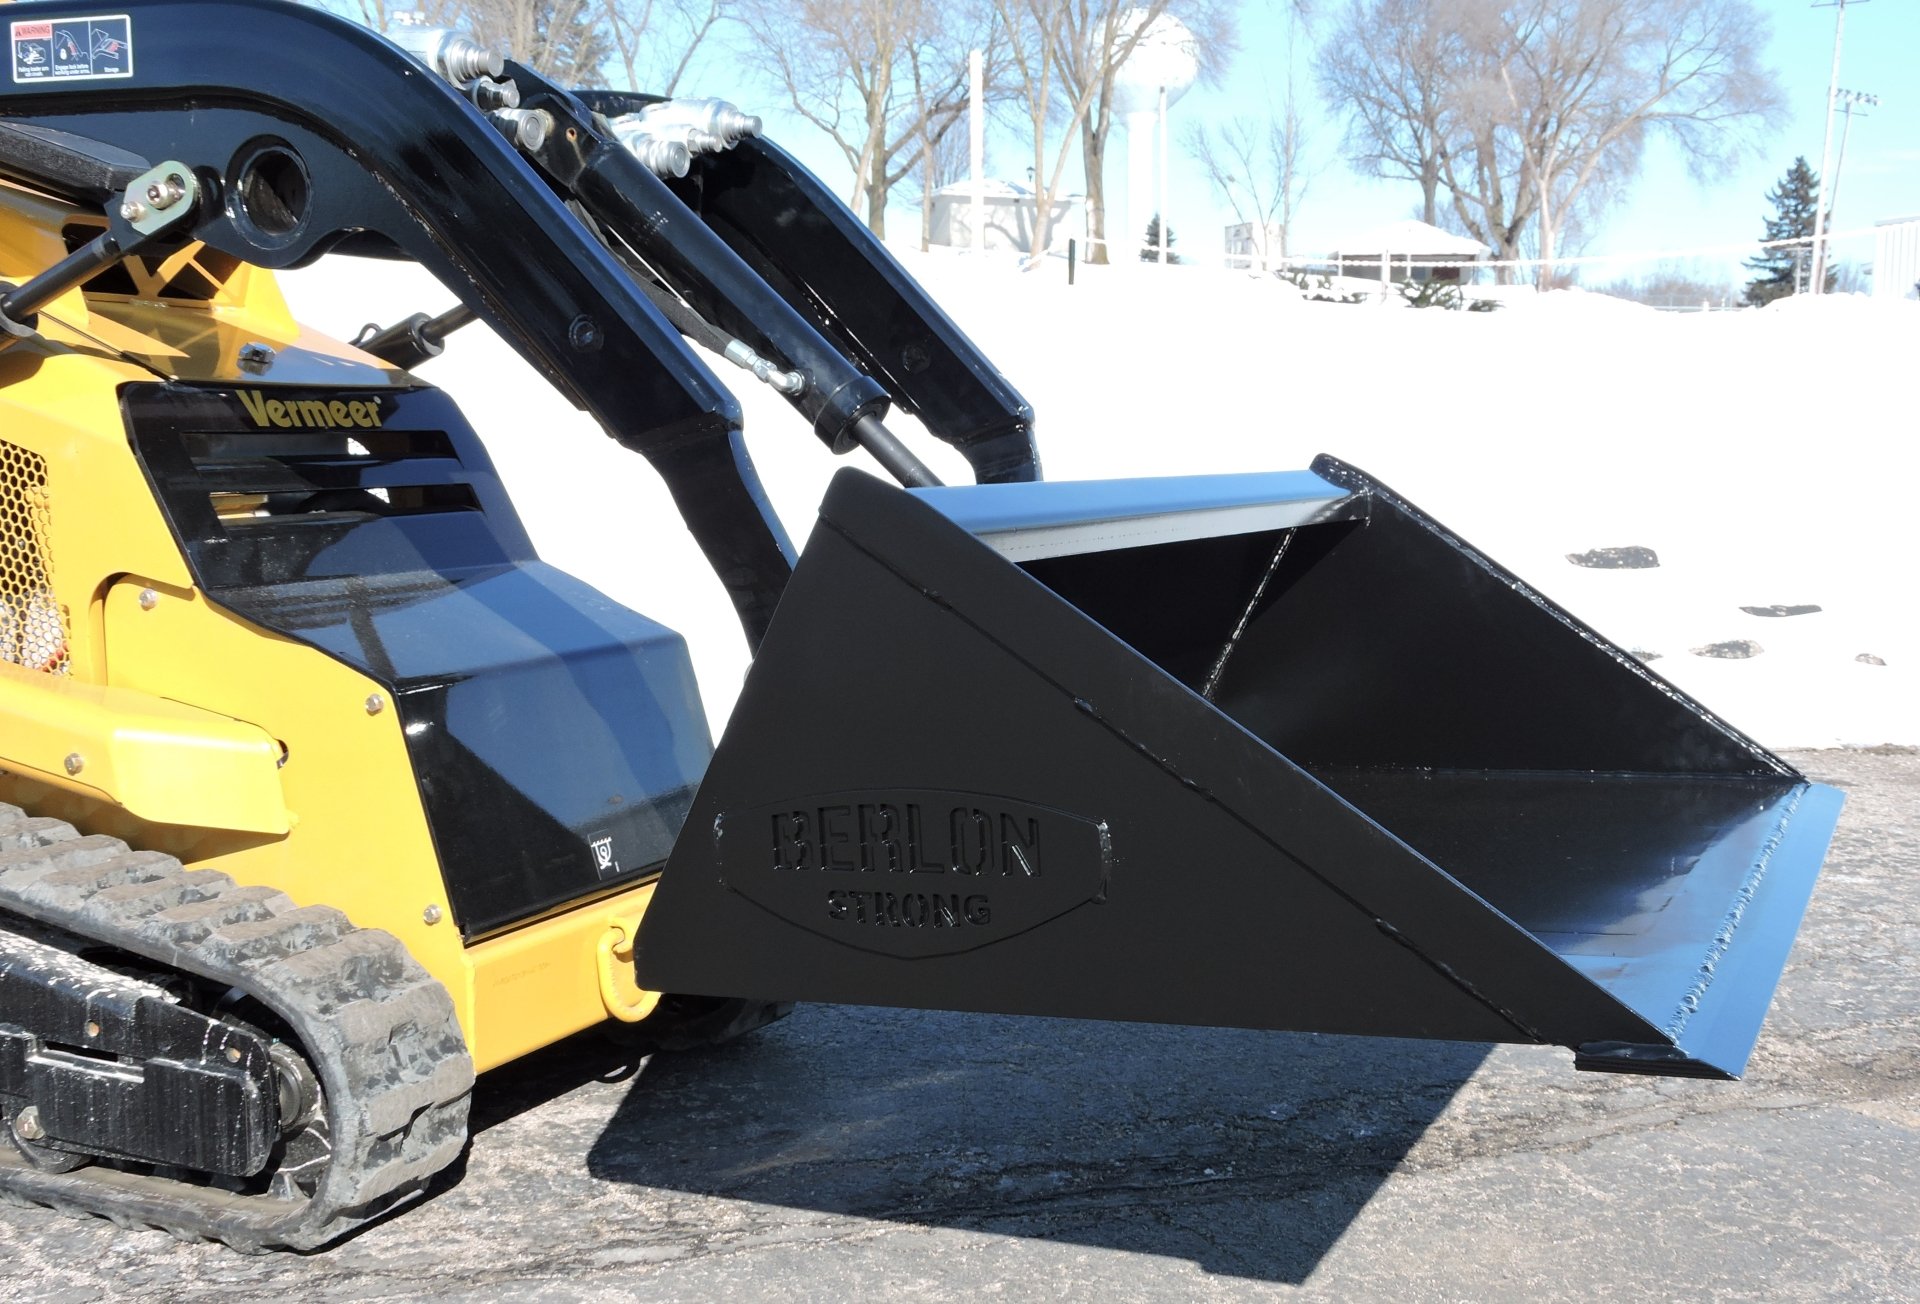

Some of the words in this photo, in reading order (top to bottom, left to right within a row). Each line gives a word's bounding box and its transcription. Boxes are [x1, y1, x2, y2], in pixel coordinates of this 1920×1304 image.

[22, 26, 50, 36] WARNING
[234, 390, 382, 428] Vermeer
[771, 803, 1042, 878] BERLON
[827, 889, 992, 929] STRONG
